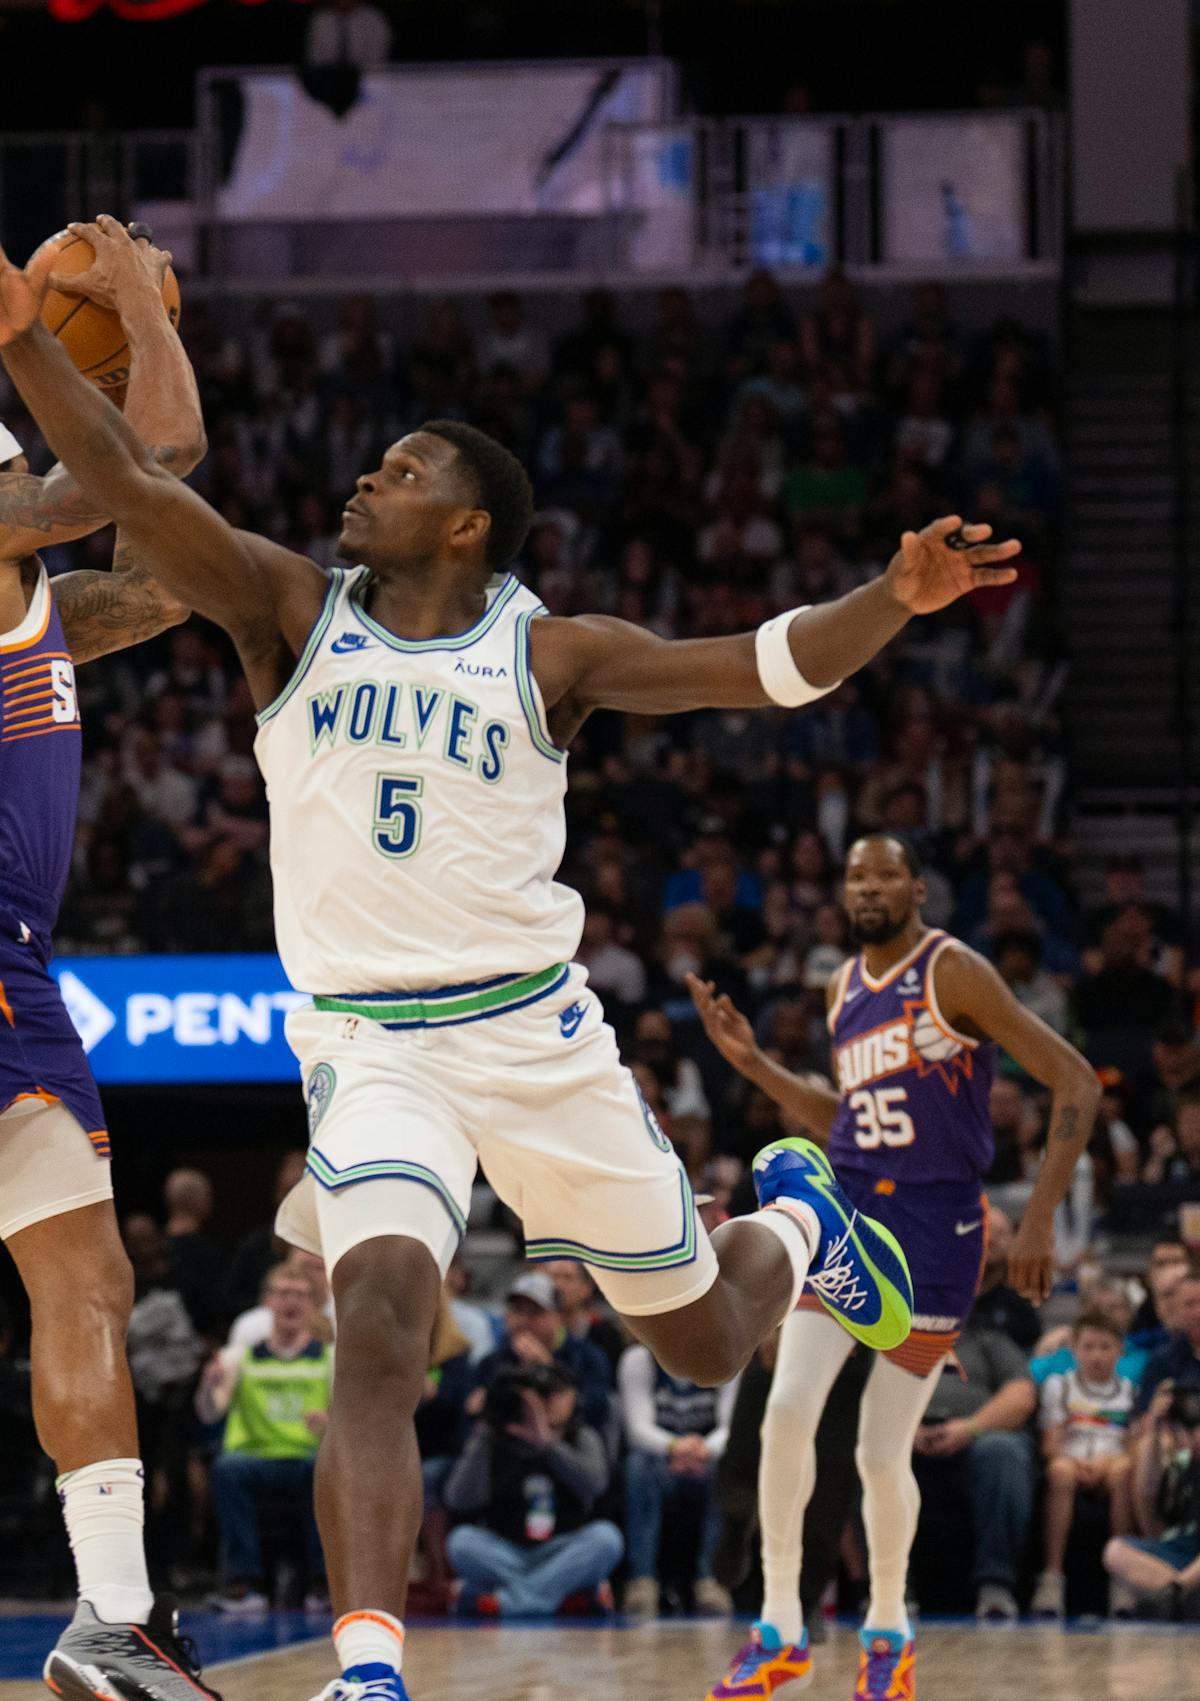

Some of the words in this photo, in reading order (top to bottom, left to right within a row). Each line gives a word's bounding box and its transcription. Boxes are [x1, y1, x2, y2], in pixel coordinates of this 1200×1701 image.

[306, 678, 511, 786] WOLVES
[371, 771, 425, 860] 5
[837, 1022, 910, 1092] UNS
[849, 1086, 916, 1150] 35
